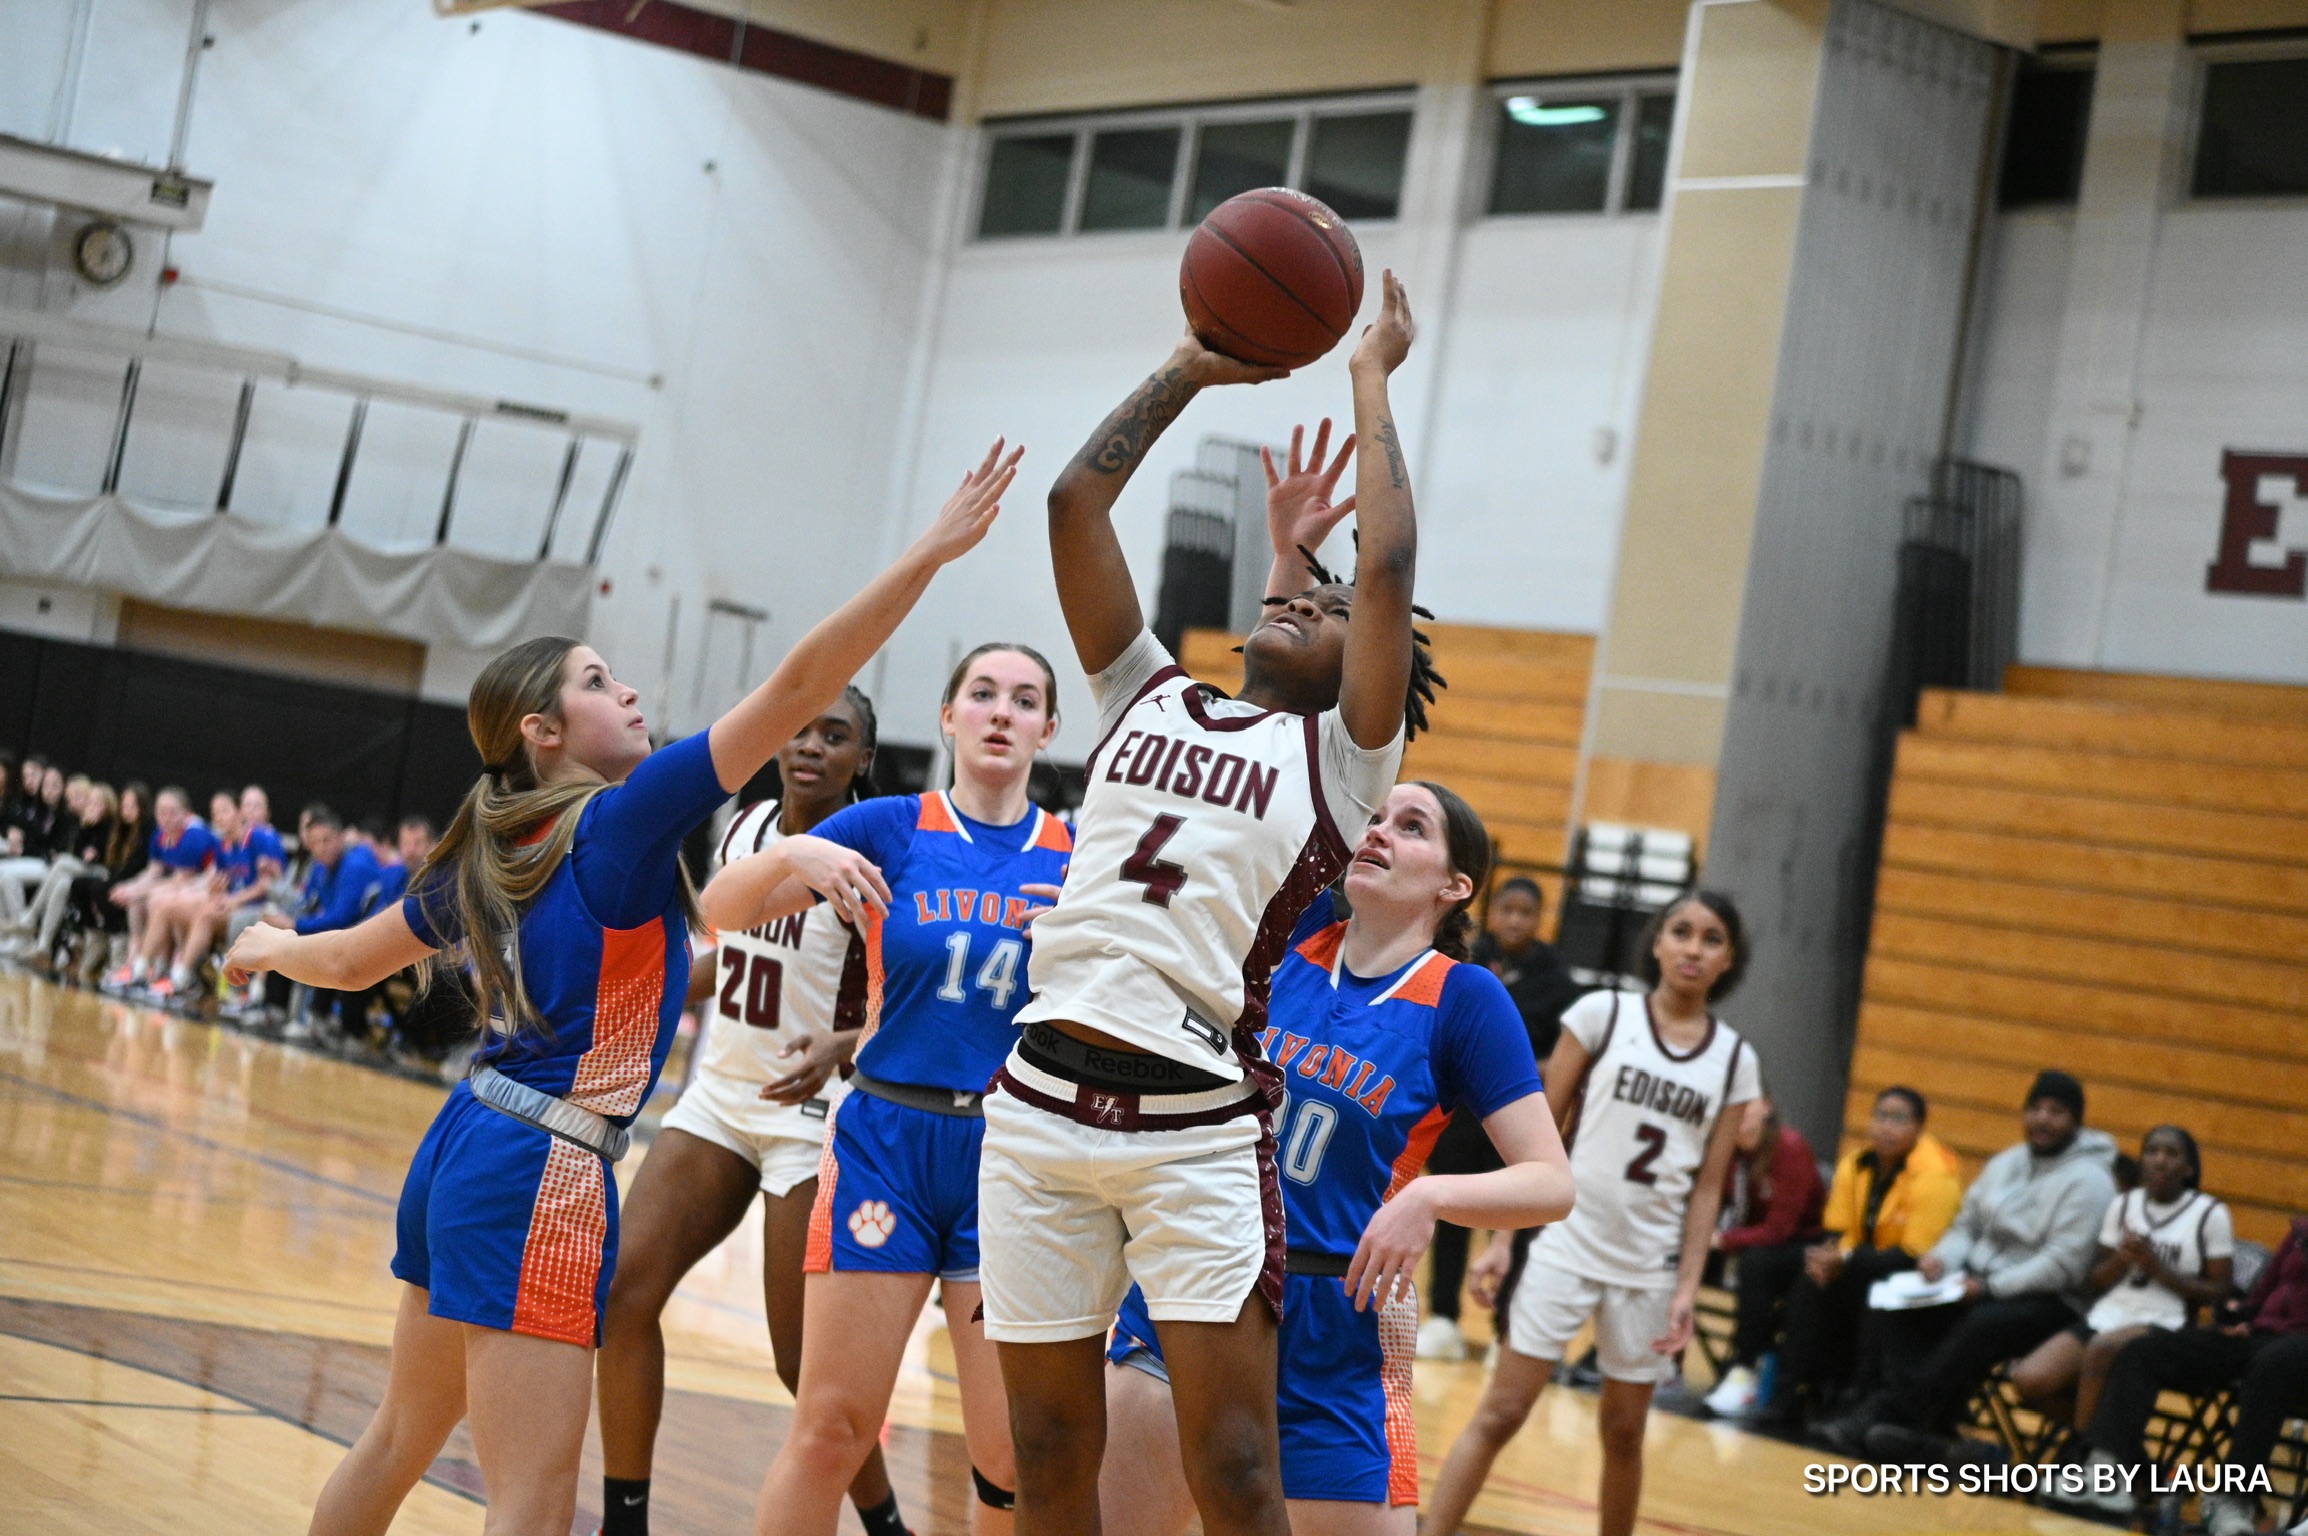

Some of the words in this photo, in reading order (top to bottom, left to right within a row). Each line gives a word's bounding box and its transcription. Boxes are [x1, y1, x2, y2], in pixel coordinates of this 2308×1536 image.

[1105, 731, 1280, 821] EDISON
[1118, 811, 1188, 910] 4
[914, 888, 1044, 931] LIVON
[719, 944, 783, 1030] 20
[936, 931, 1023, 1010] 14
[1084, 1050, 1184, 1081] Reebok
[1262, 1026, 1396, 1119] IVONIA
[1613, 1064, 1711, 1128] EDISON
[1624, 1122, 1668, 1186] 2
